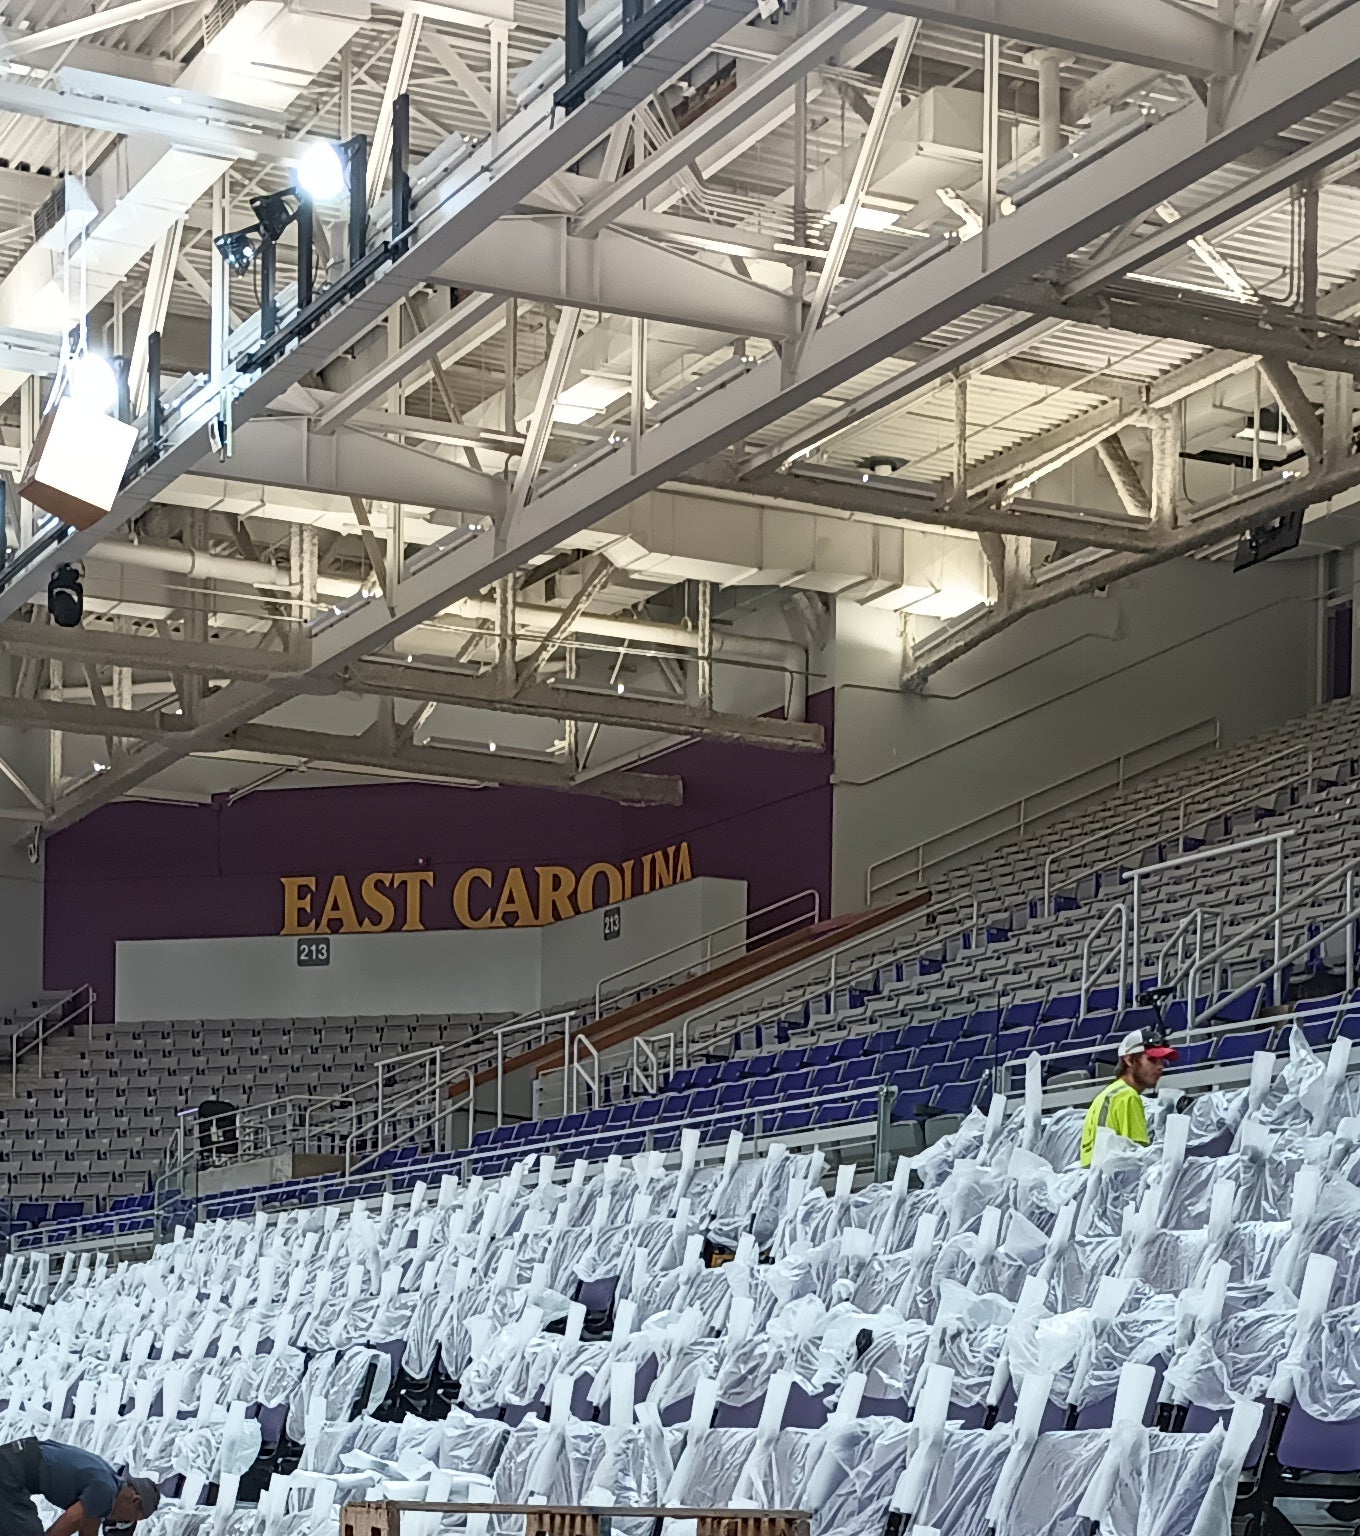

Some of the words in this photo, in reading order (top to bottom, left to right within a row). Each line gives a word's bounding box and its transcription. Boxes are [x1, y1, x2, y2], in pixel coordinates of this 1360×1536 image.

[280, 871, 434, 936] EAST
[452, 841, 693, 930] CAROLINA
[603, 914, 621, 934] 213
[300, 943, 328, 961] 213
